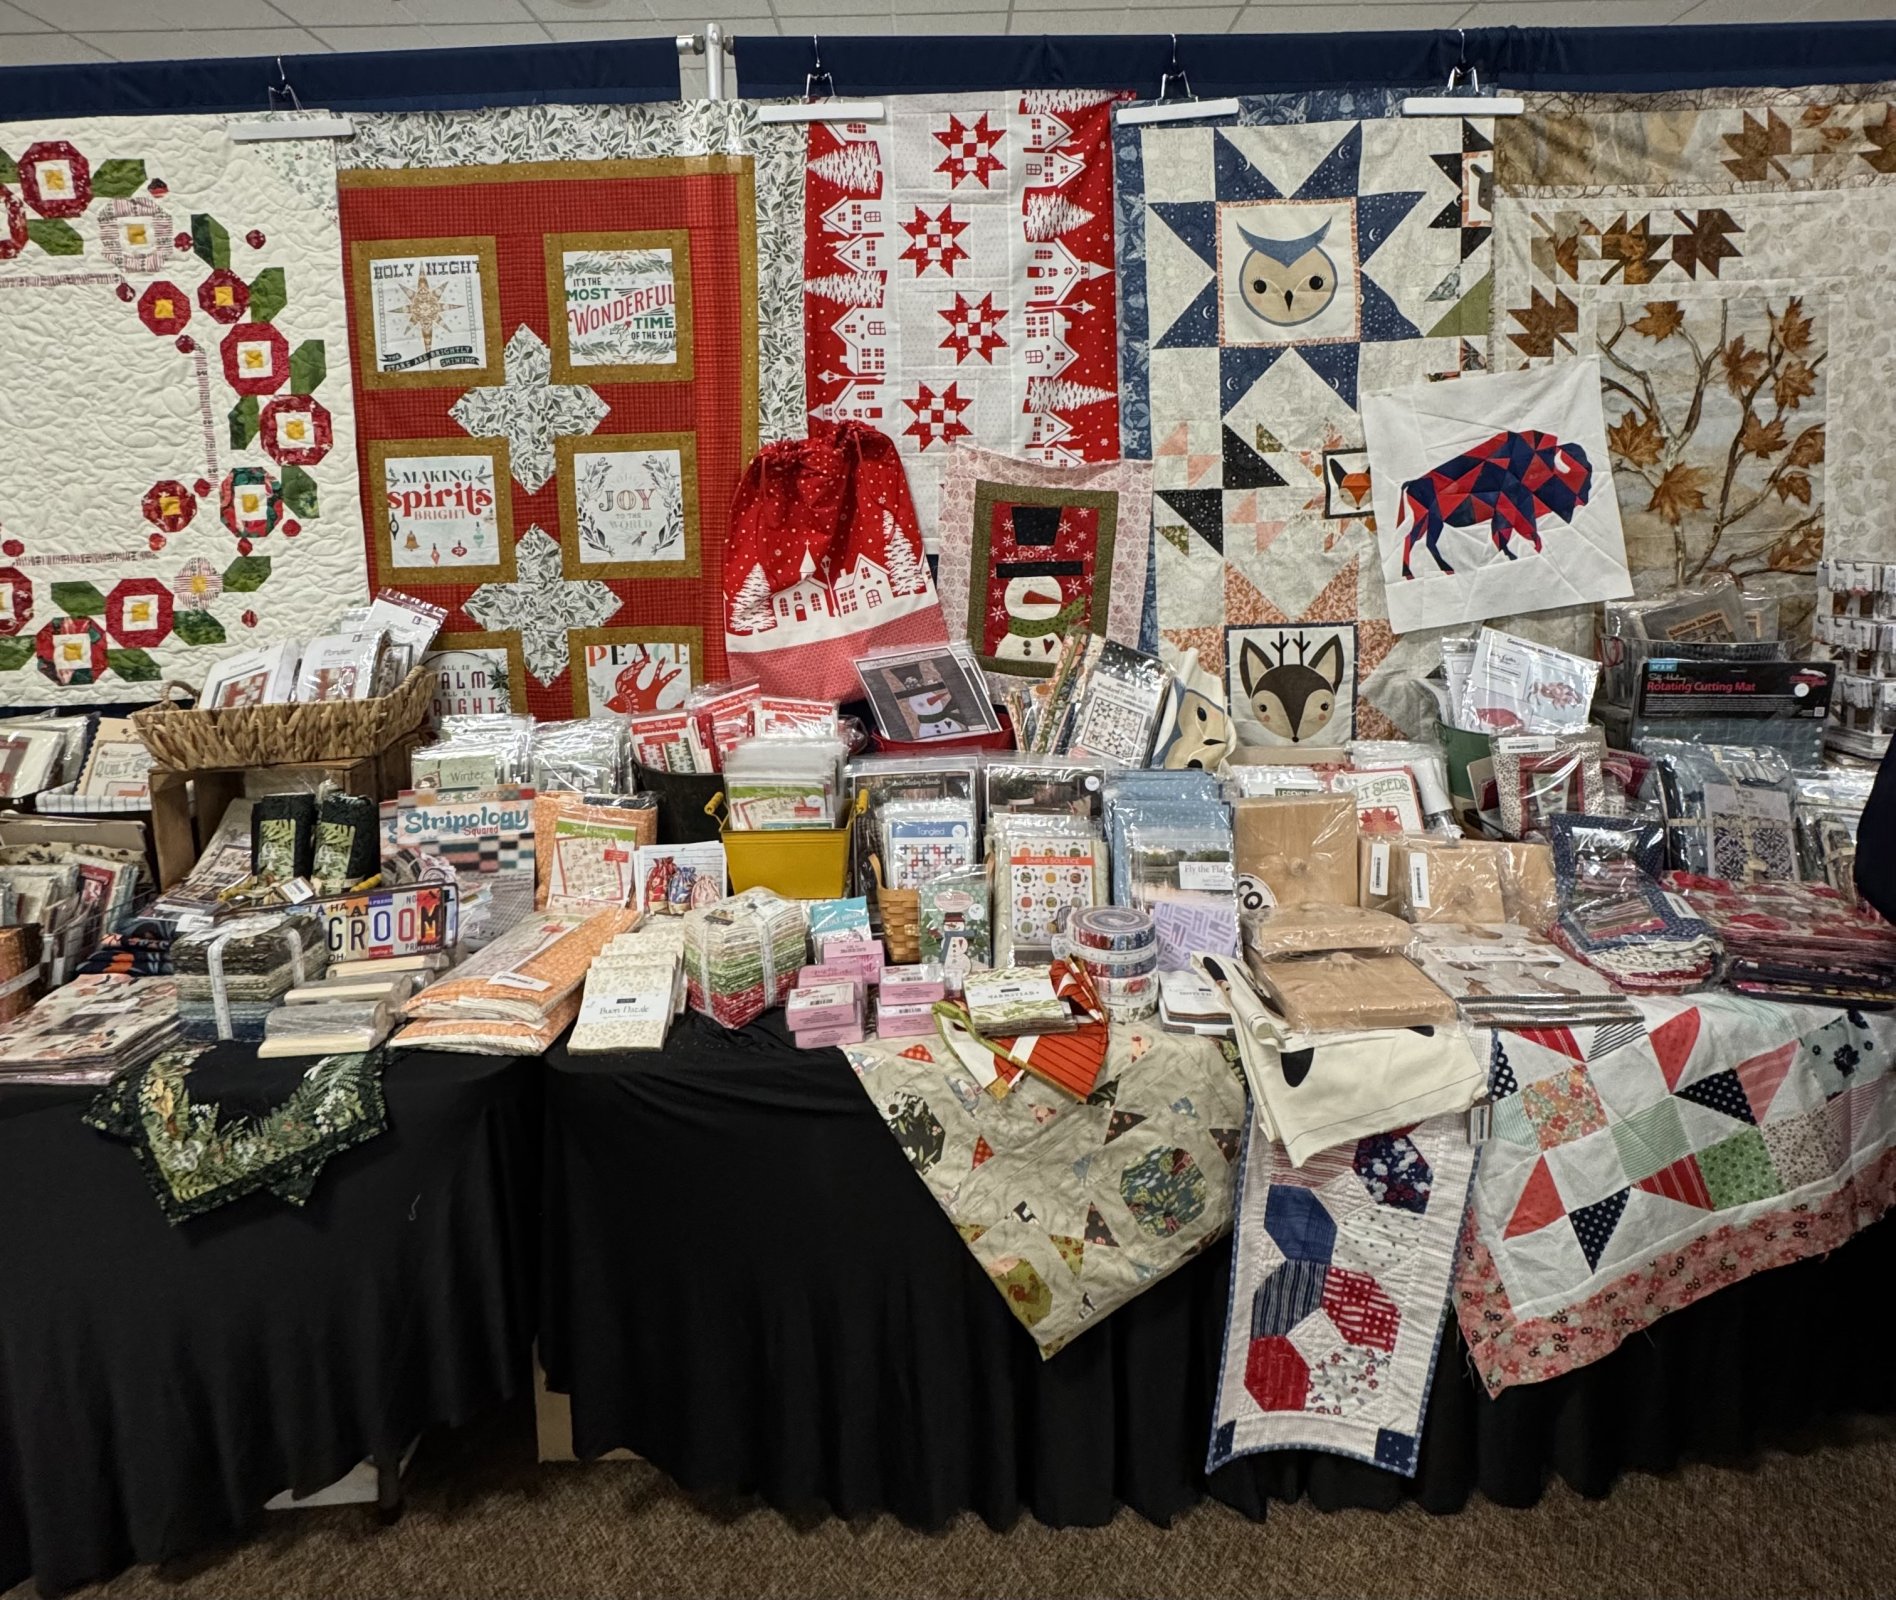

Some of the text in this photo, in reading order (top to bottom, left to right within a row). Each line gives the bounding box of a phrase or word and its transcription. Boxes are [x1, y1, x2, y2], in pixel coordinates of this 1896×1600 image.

[373, 260, 480, 280] HOLY NIGHT
[573, 277, 602, 287] IT'S THE
[565, 288, 612, 301] MOST
[568, 284, 675, 336] WONDERFUL
[633, 317, 674, 329] TIME
[631, 331, 640, 340] OF
[642, 331, 657, 340] THE
[414, 353, 429, 365] ARE
[430, 347, 470, 359] BRIGHTLY
[440, 357, 476, 367] SHINING
[403, 469, 472, 484] MAKING
[386, 482, 492, 517] spirits
[598, 488, 656, 512] JOY
[414, 509, 465, 521] BRIGHT
[609, 520, 652, 529] WORLD
[588, 643, 688, 667] PEACE
[441, 670, 486, 690] ALM
[1647, 681, 1756, 693] Rotating Cutting Mat
[433, 697, 496, 716] RIGHT
[451, 770, 487, 783] Winter
[1372, 777, 1410, 797] SEEDS
[405, 806, 529, 834] Stripology
[463, 825, 499, 838] Squared
[917, 825, 945, 837] Tangled
[1184, 864, 1197, 875] Fly
[1197, 864, 1210, 873] the
[328, 905, 441, 952] GROOM
